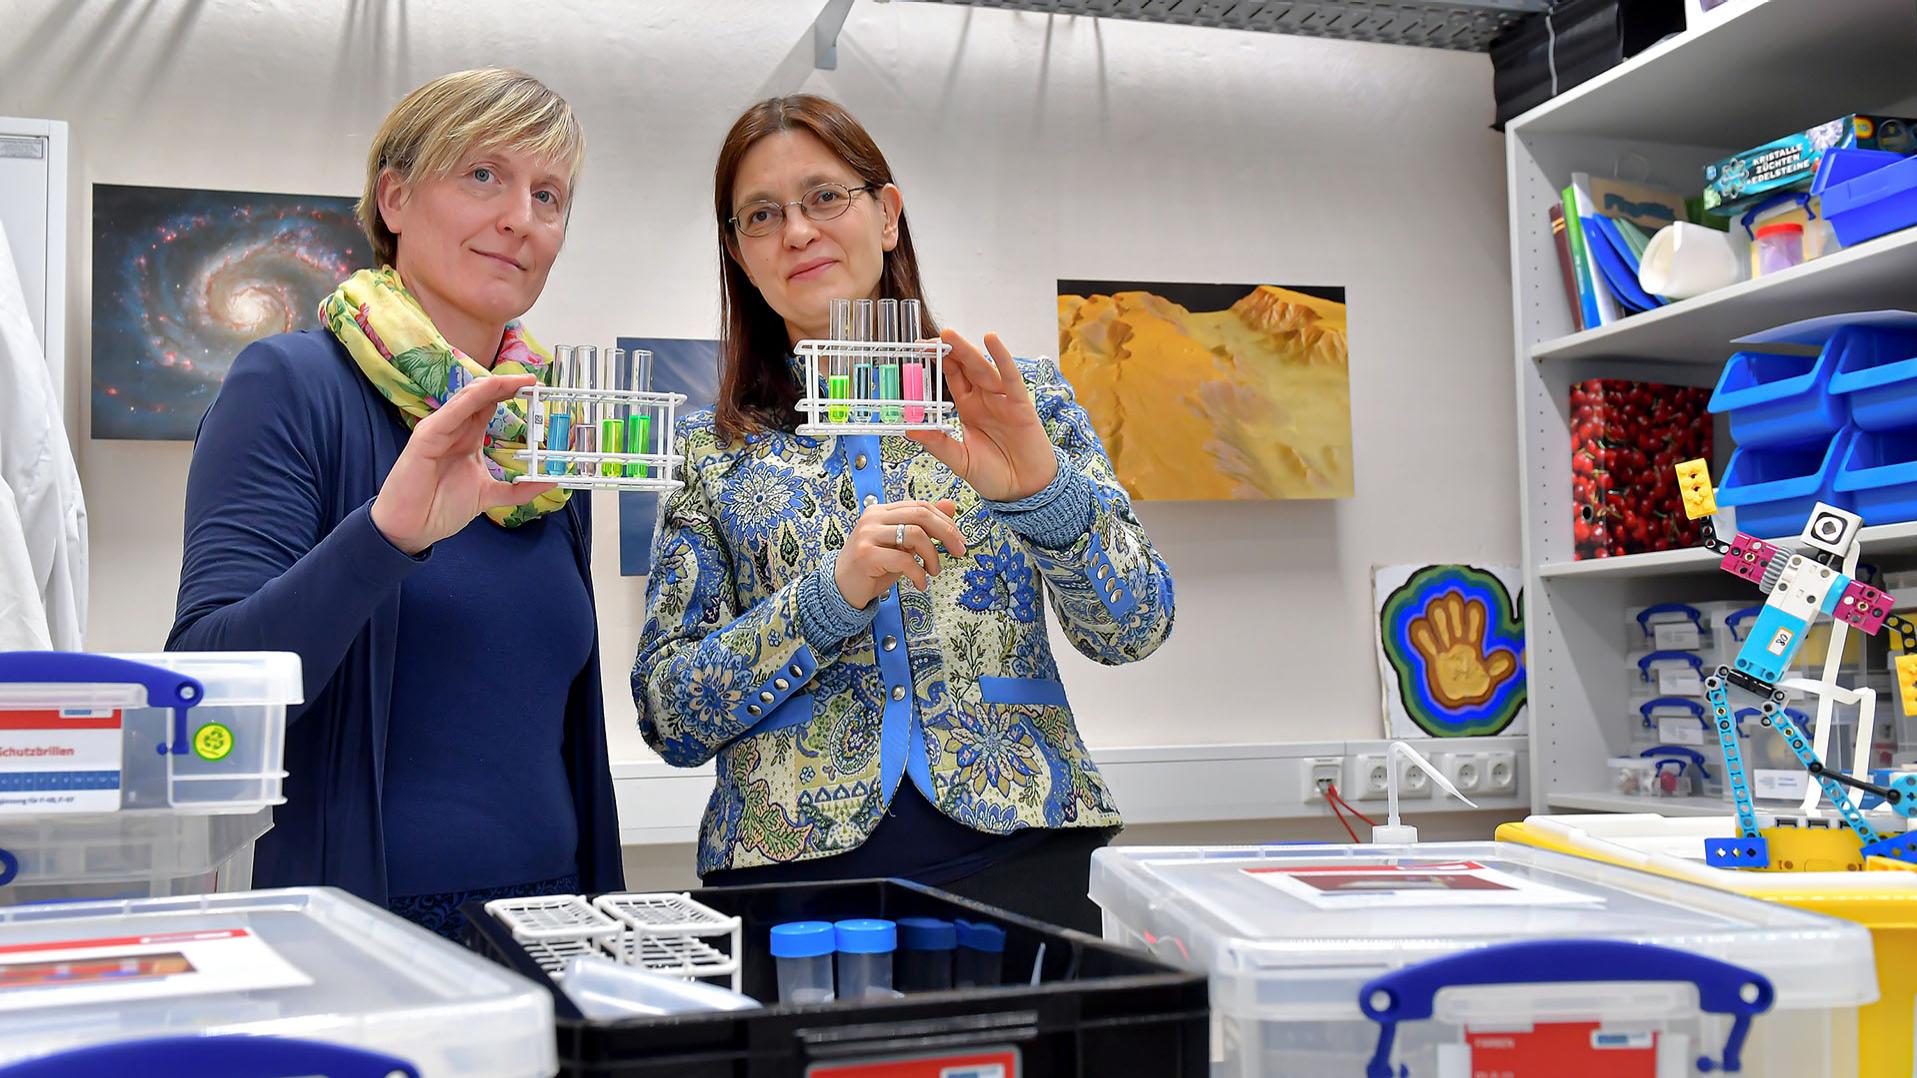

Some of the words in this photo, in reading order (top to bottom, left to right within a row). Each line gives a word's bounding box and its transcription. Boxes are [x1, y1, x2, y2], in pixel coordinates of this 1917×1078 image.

[1752, 143, 1804, 167] KRISTALLE
[1755, 153, 1800, 175] ZÜCHTEN
[1751, 159, 1810, 185] EDELSTEINE
